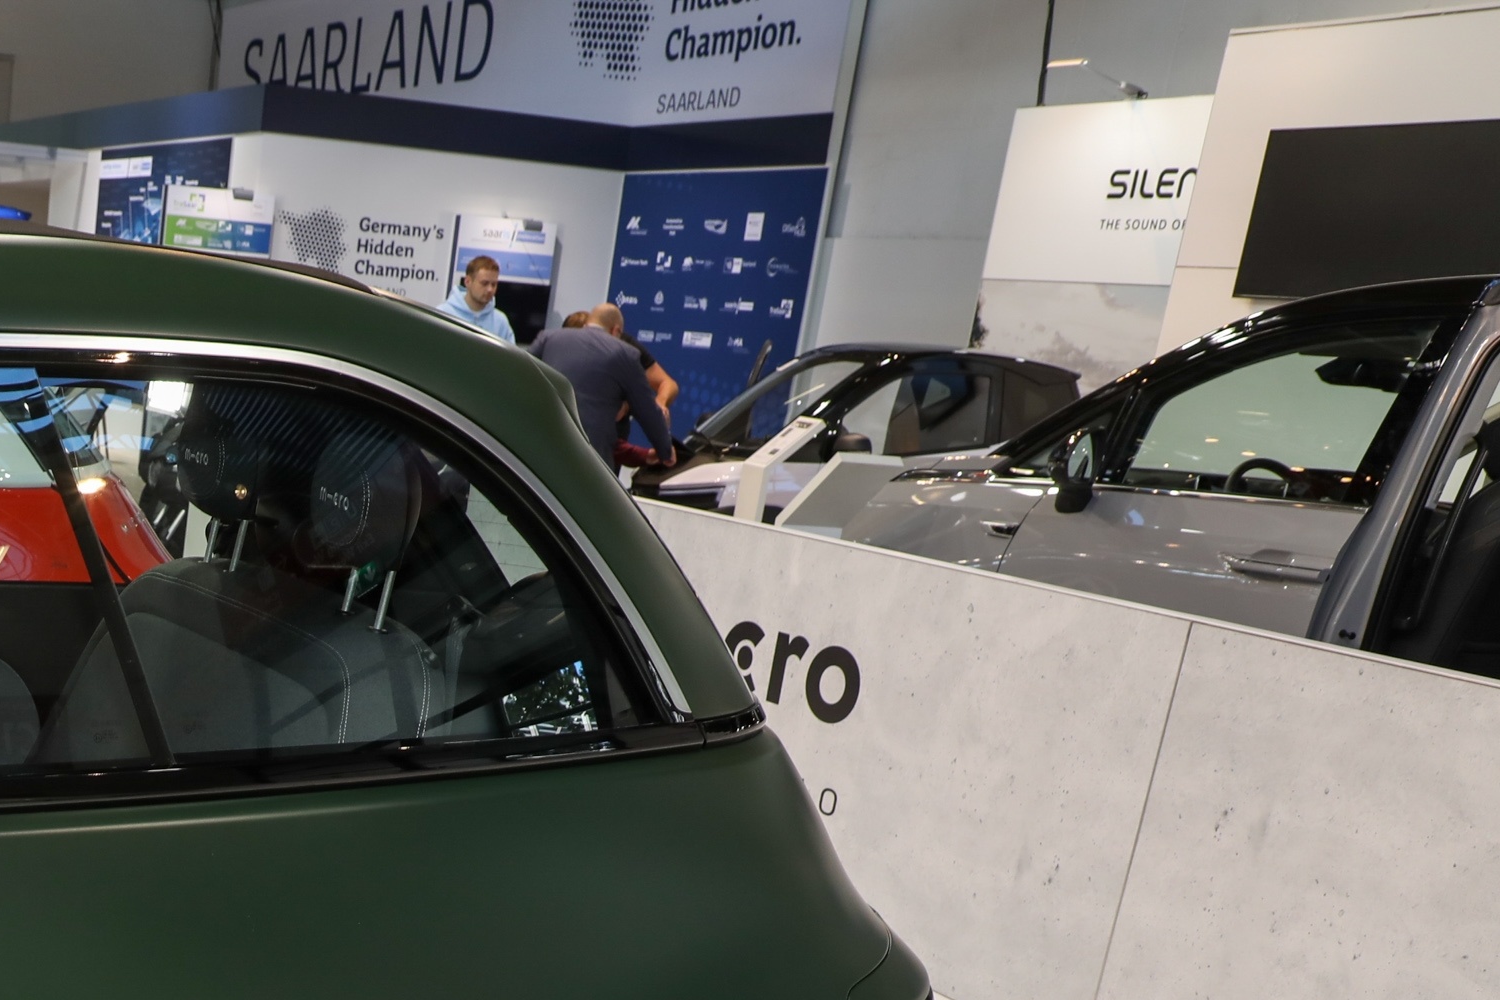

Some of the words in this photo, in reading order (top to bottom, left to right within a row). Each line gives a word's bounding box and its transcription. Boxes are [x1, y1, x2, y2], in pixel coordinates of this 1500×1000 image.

[244, 0, 494, 94] SAARLAND
[665, 14, 802, 62] Champion.
[656, 86, 741, 115] SAARLAND
[359, 216, 445, 242] Germany's
[1100, 218, 1121, 230] THE
[1124, 218, 1168, 231] SOUND
[356, 238, 414, 258] Hidden
[354, 259, 439, 283] Champion.
